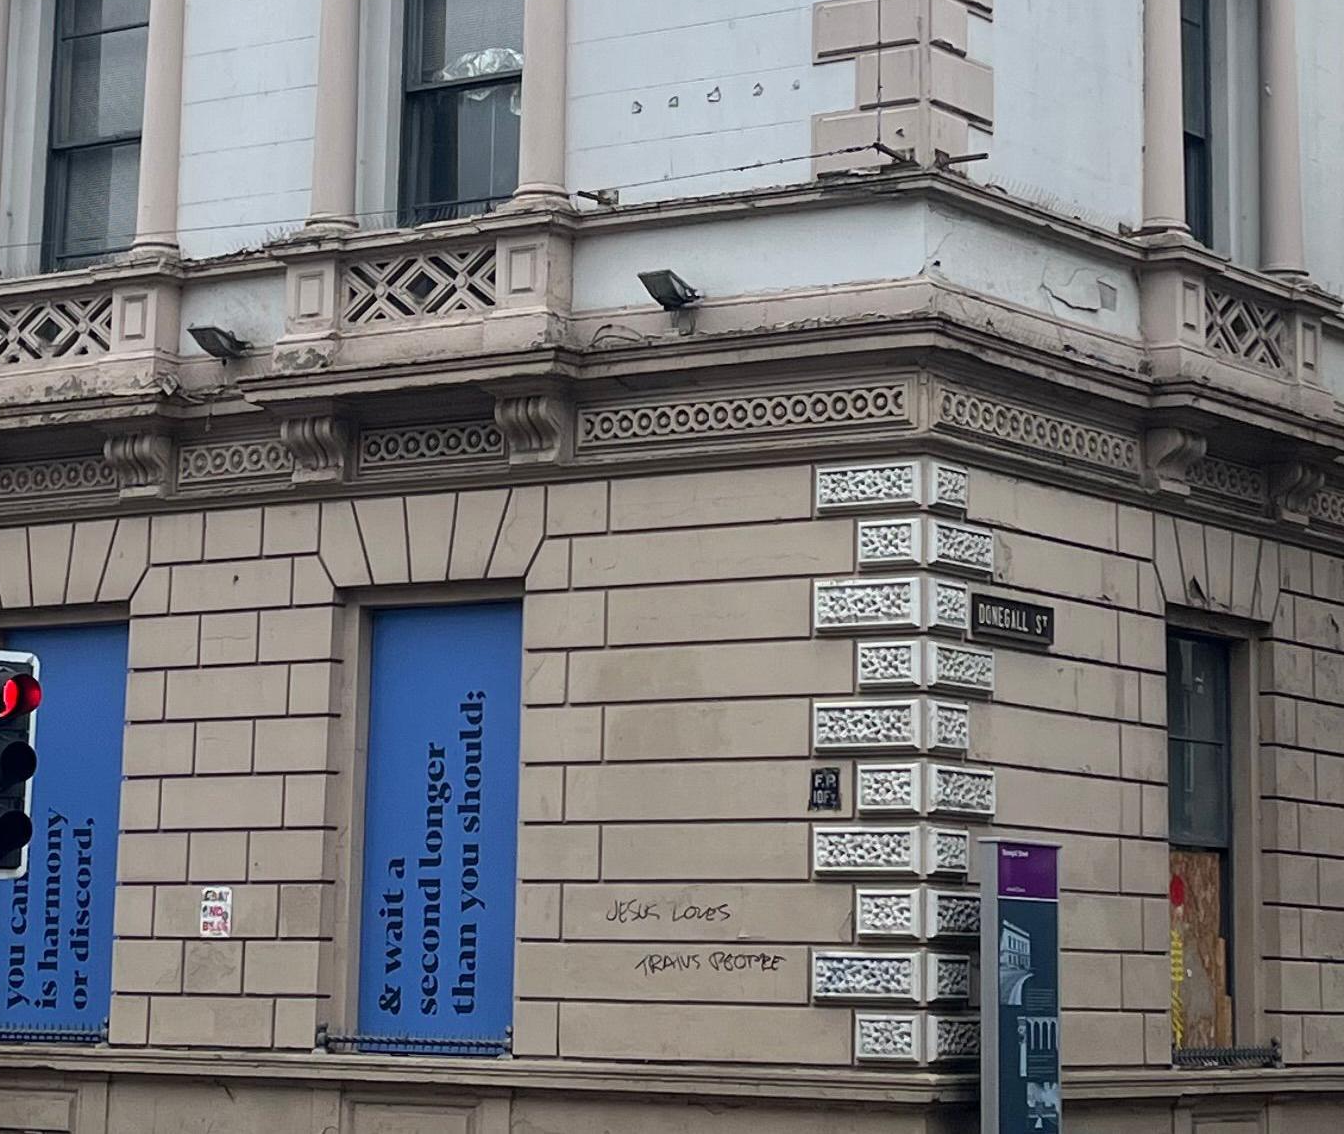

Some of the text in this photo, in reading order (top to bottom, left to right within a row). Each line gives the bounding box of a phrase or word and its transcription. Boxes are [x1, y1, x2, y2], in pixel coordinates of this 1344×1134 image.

[978, 603, 1029, 632] DONEGALL
[34, 807, 68, 1009] is harmony
[70, 817, 95, 1010] or discord,
[379, 857, 405, 1016] & wait a
[418, 742, 452, 1016] second longer
[452, 690, 487, 1016] than you should;
[606, 898, 731, 924] JESUS LOVES
[7, 945, 30, 1009] you
